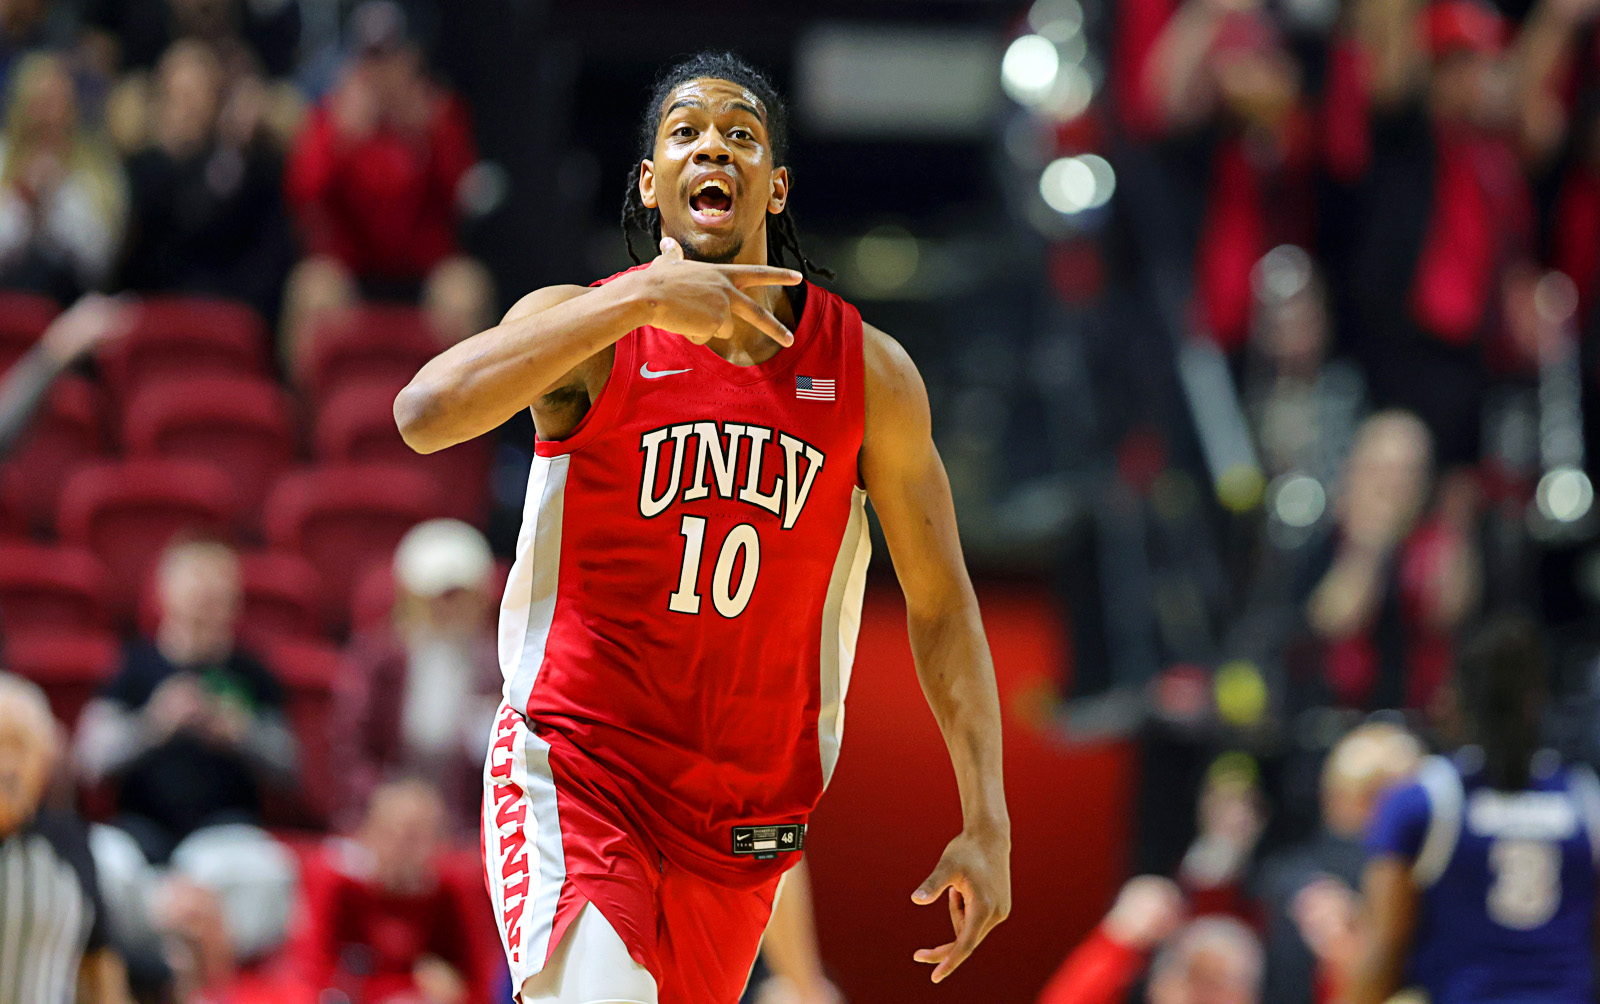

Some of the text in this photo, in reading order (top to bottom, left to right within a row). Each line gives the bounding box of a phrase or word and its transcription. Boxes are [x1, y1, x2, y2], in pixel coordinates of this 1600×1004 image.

[638, 420, 826, 530] UNLV
[667, 513, 761, 619] 10
[781, 831, 794, 844] 48
